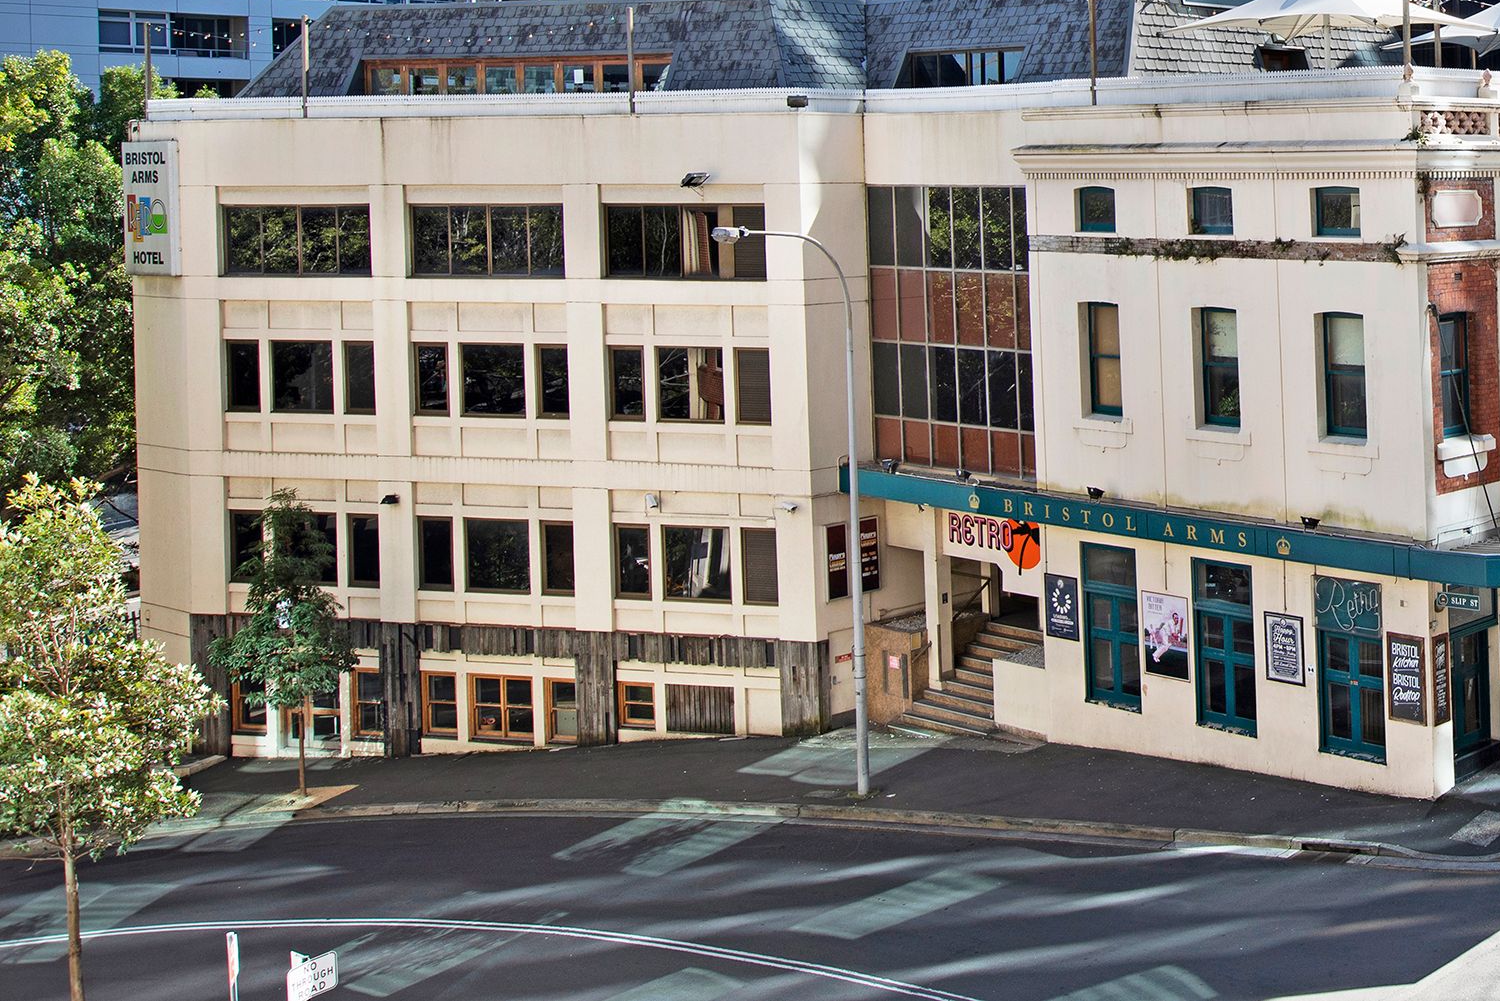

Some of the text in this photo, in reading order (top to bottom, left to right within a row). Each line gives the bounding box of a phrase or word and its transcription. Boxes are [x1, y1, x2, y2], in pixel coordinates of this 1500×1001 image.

[126, 152, 165, 165] BRISTOL
[132, 170, 158, 183] ARMS
[133, 251, 164, 265] HOTEL
[1003, 498, 1248, 547] BRISTOL ARMS
[949, 512, 1014, 552] RETRO
[1451, 596, 1478, 607] SLIP ST
[1391, 642, 1420, 659] BRISTOL
[1393, 656, 1419, 668] Kitchen
[1393, 673, 1420, 689] BRISTOL
[1392, 686, 1420, 702] Rooftop
